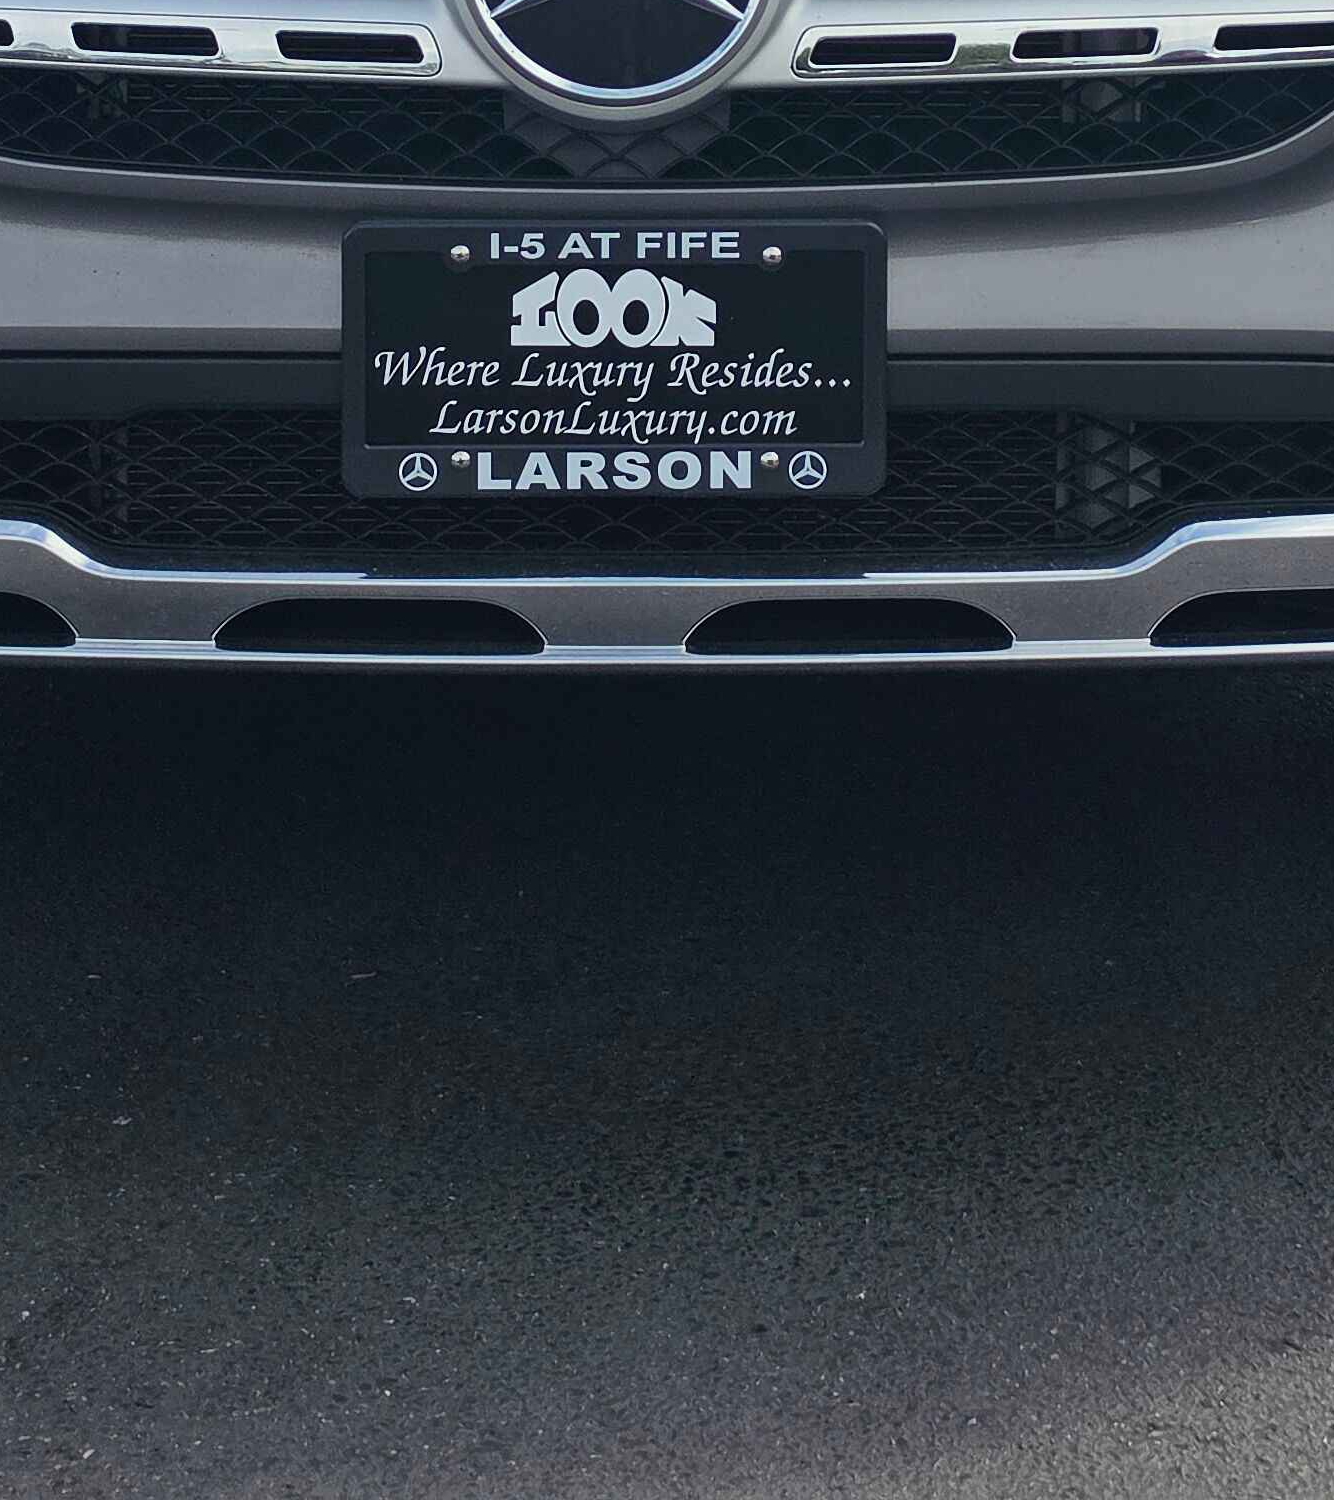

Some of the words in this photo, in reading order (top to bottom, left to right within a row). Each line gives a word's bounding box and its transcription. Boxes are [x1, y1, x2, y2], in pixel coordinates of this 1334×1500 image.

[490, 232, 545, 259] I-5
[557, 232, 620, 259] AT
[636, 231, 740, 259] FIFE
[375, 346, 500, 387] Where
[511, 353, 655, 403] Luxury
[667, 348, 851, 396] Resides...
[429, 399, 797, 444] LarsonLuxury.com
[477, 450, 752, 490] LARSON
